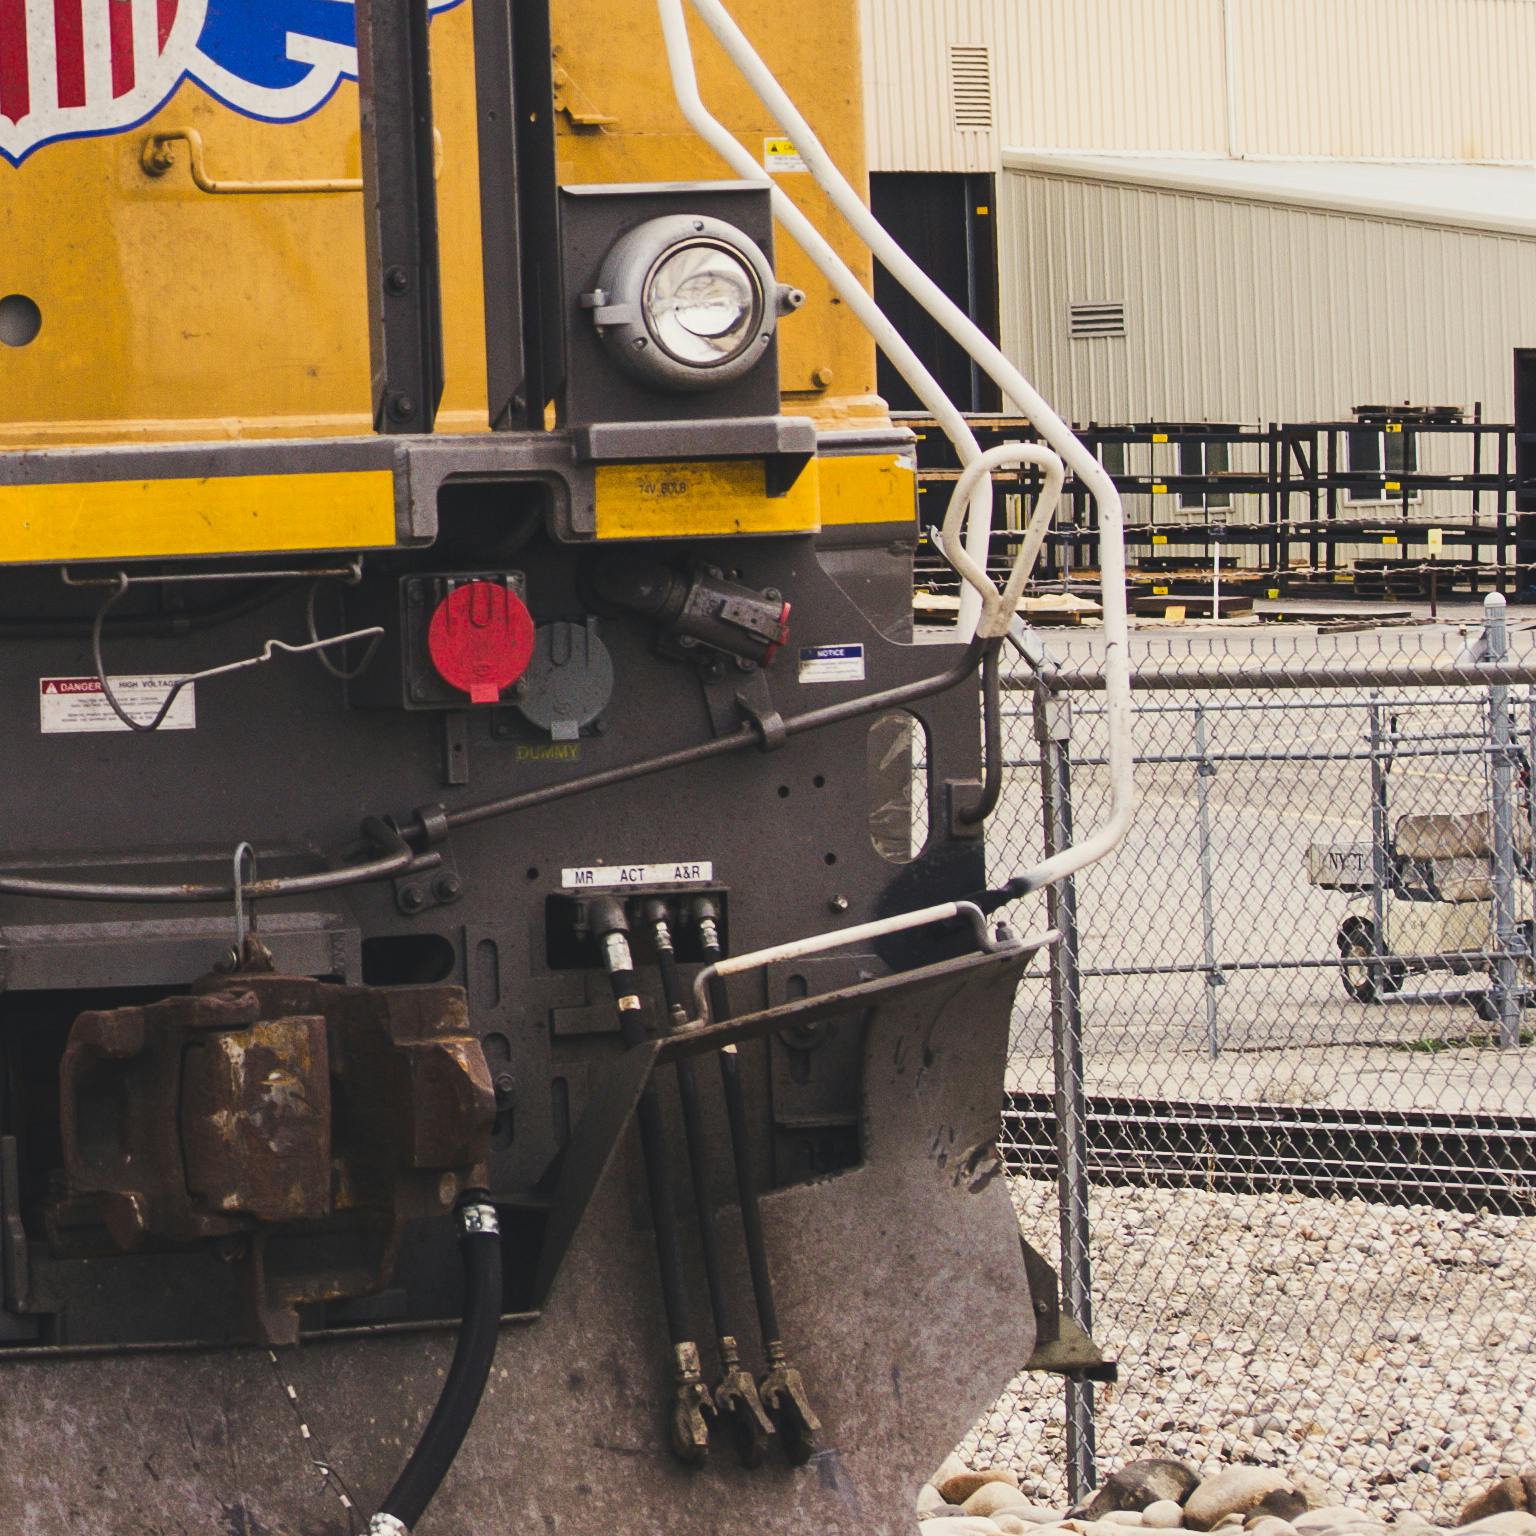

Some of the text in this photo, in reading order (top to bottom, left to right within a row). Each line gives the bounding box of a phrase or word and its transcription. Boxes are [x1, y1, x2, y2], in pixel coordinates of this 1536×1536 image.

[816, 648, 845, 657] NOTICE
[60, 681, 103, 692] DANGER
[118, 680, 138, 689] HIGH
[515, 744, 578, 761] DUMMY
[574, 865, 700, 885] MR ACT A&R
